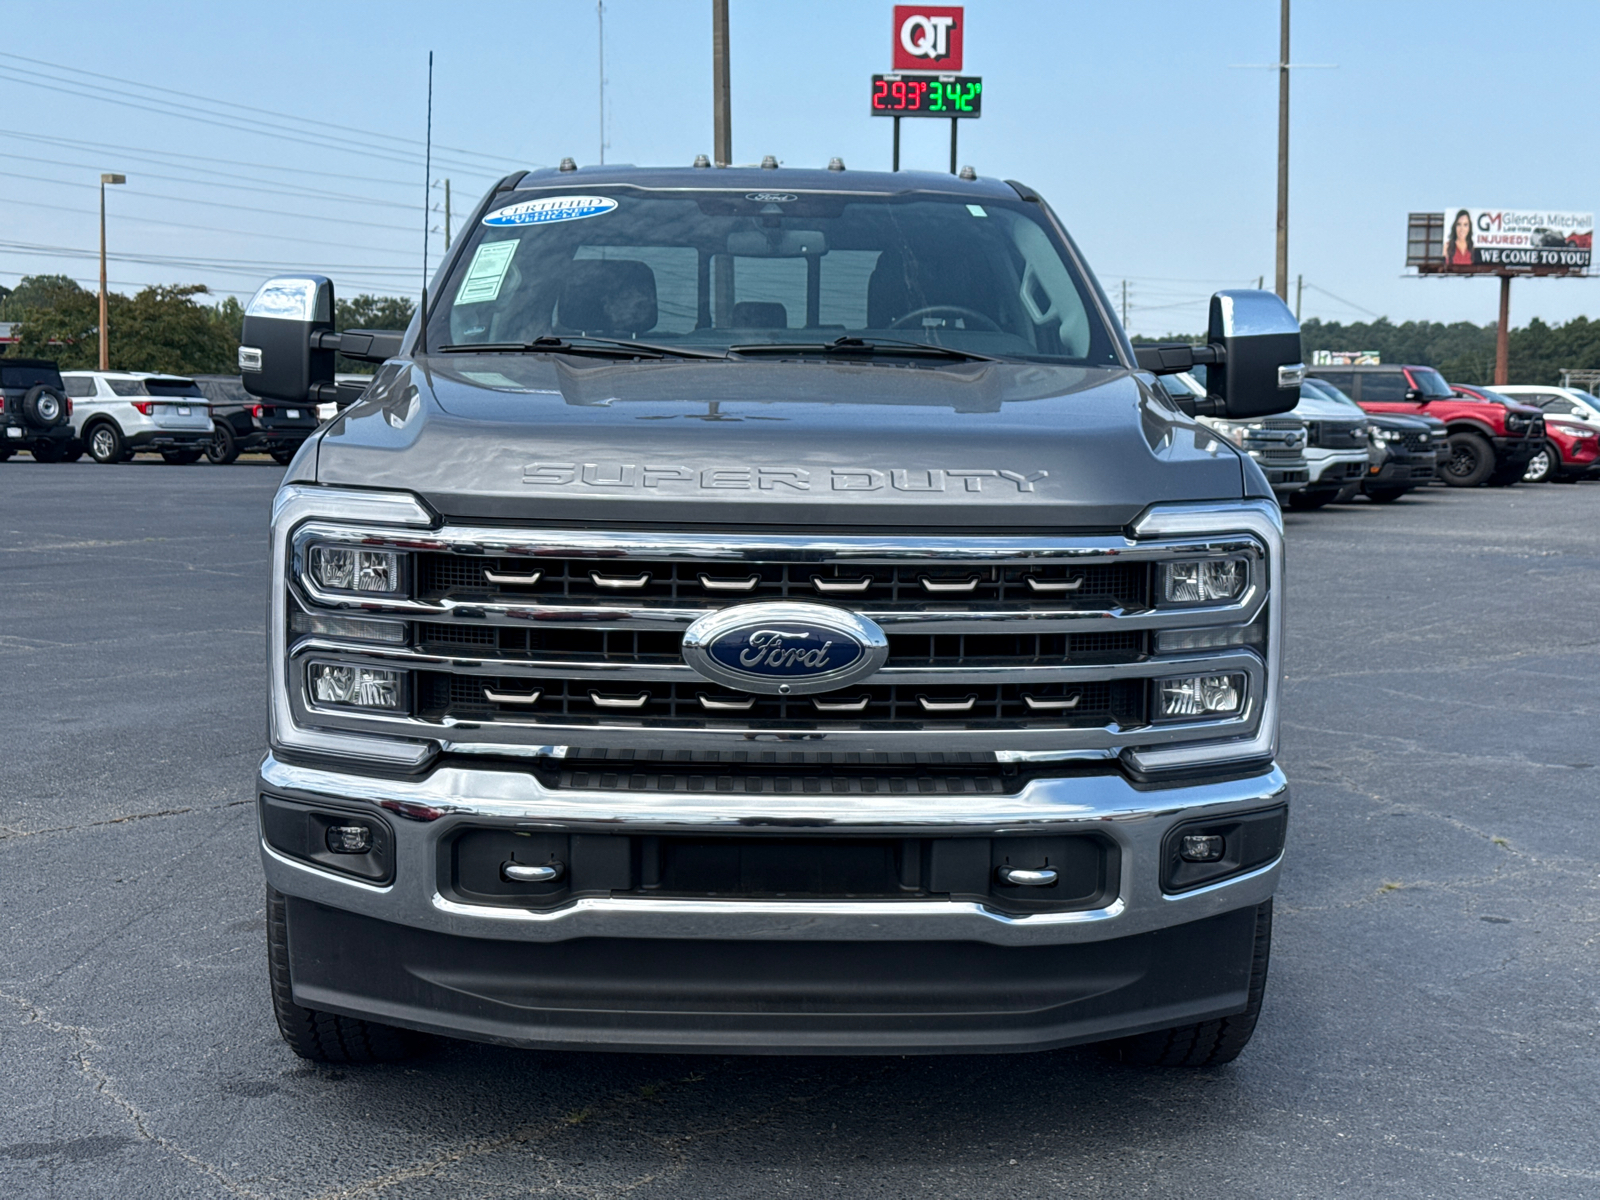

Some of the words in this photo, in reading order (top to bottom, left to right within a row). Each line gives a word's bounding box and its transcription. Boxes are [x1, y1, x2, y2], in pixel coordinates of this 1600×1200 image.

[900, 14, 957, 62] QT
[754, 193, 789, 201] Ford
[499, 198, 603, 216] CERTIFIED
[515, 212, 581, 223] VEHICLE
[1477, 212, 1502, 232] GM
[1502, 212, 1544, 226] Glenda
[1547, 213, 1592, 228] Mitchell
[1477, 234, 1529, 245] INJURED?
[1480, 249, 1500, 263] WE
[1501, 249, 1539, 264] COME
[1540, 250, 1559, 265] TO
[1560, 251, 1590, 265] YOU!
[522, 461, 810, 491] SUPER
[831, 468, 1049, 493] DUTY
[739, 629, 833, 668] Ford
